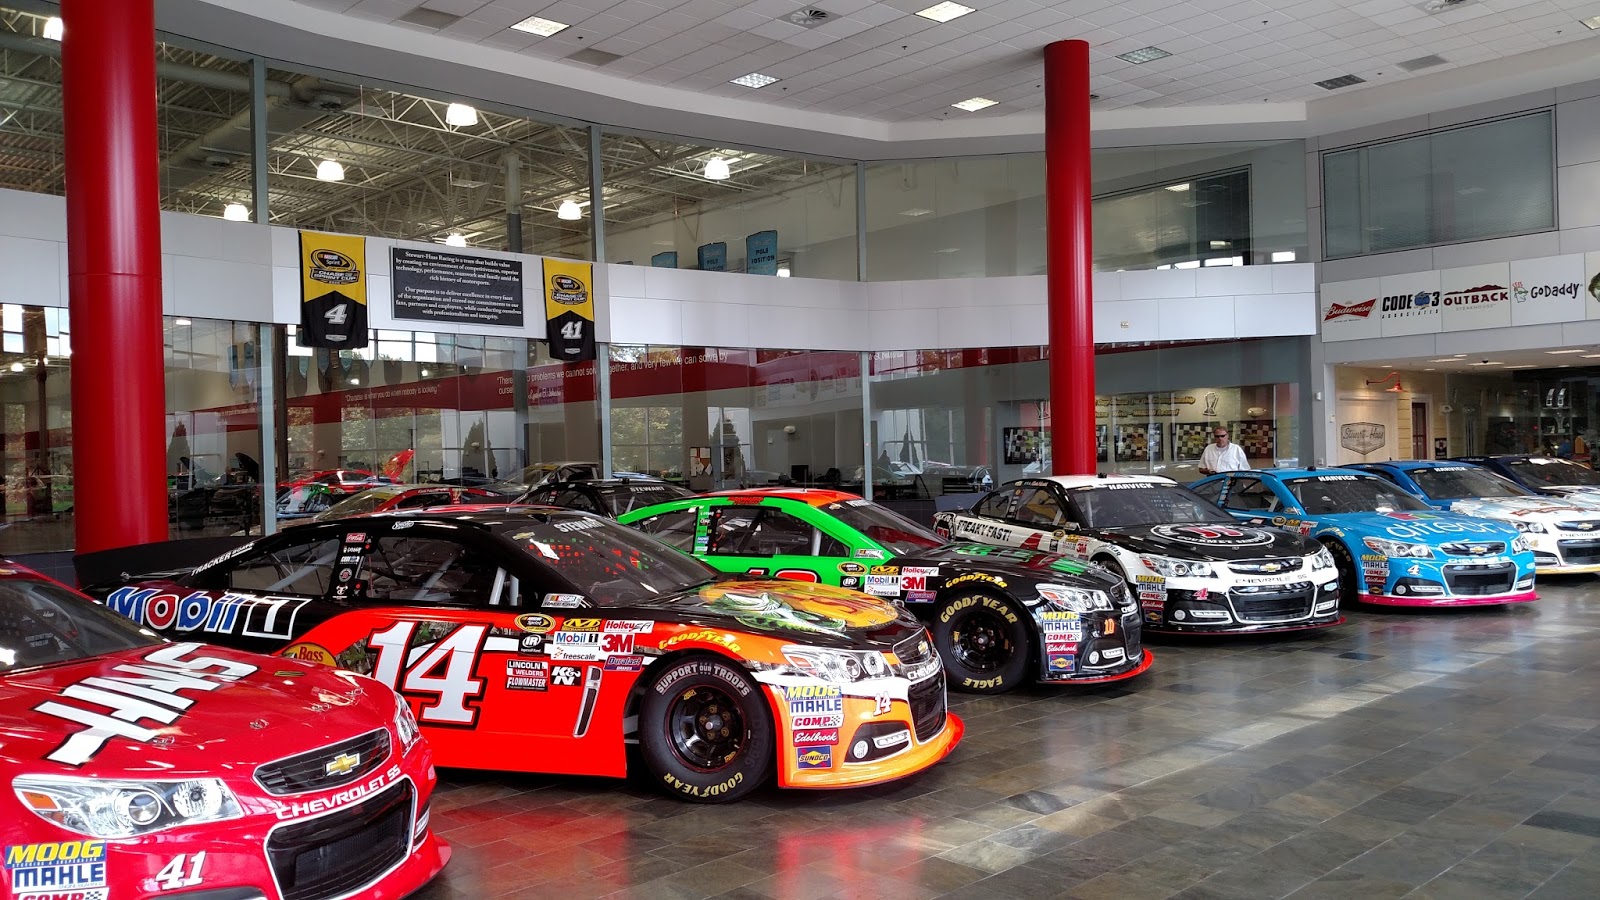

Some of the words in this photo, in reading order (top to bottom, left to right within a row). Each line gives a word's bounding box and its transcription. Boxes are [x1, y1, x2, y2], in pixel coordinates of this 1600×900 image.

[439, 255, 455, 263] Racing
[1443, 292, 1509, 306] OUTBACK
[1531, 283, 1580, 299] GoDaddy
[1382, 294, 1413, 312] CODE
[1432, 291, 1440, 306] 3
[324, 304, 347, 324] 4
[1325, 303, 1376, 317] Budweiser
[560, 321, 582, 339] 41
[566, 368, 585, 378] cannot
[644, 360, 658, 370] very
[660, 357, 672, 366] few
[685, 355, 697, 365] can
[957, 519, 988, 536] FREAKY
[191, 551, 232, 576] TRACKER
[903, 567, 925, 575] Holley
[1407, 564, 1420, 575] 4
[902, 577, 925, 590] 3M
[945, 572, 1008, 589] GOODYEAR
[1193, 587, 1208, 600] 4
[106, 586, 243, 634] Mobil
[940, 594, 1019, 624] GOODYEAR
[1043, 611, 1080, 620] MOOG
[606, 620, 635, 632] Holley
[1045, 622, 1080, 631] MAHLE
[1104, 618, 1115, 635] 10
[556, 633, 586, 643] Mobil
[601, 634, 632, 653] 3M
[658, 630, 741, 653] GOODYEAR
[1047, 633, 1073, 641] COMP
[299, 646, 324, 662] Bass
[608, 657, 641, 665] Duralast
[368, 620, 488, 726] 14
[508, 661, 541, 669] LINCOLN
[506, 677, 546, 688] FLOWMASTER
[656, 663, 698, 695] SUPPORT
[714, 665, 750, 696] TROOPS
[962, 674, 1003, 690] EAGLE
[786, 685, 840, 698] MOOG
[791, 699, 841, 713] MAHLE
[873, 691, 892, 717] 14
[794, 716, 831, 727] COMP
[794, 731, 838, 743] Edelbrock
[275, 775, 385, 820] CHEVROLET
[387, 764, 402, 782] SS
[664, 772, 744, 798] GOODYEAR
[7, 840, 105, 865] MOOG
[15, 863, 104, 888] MAHLE
[155, 850, 207, 890] 41
